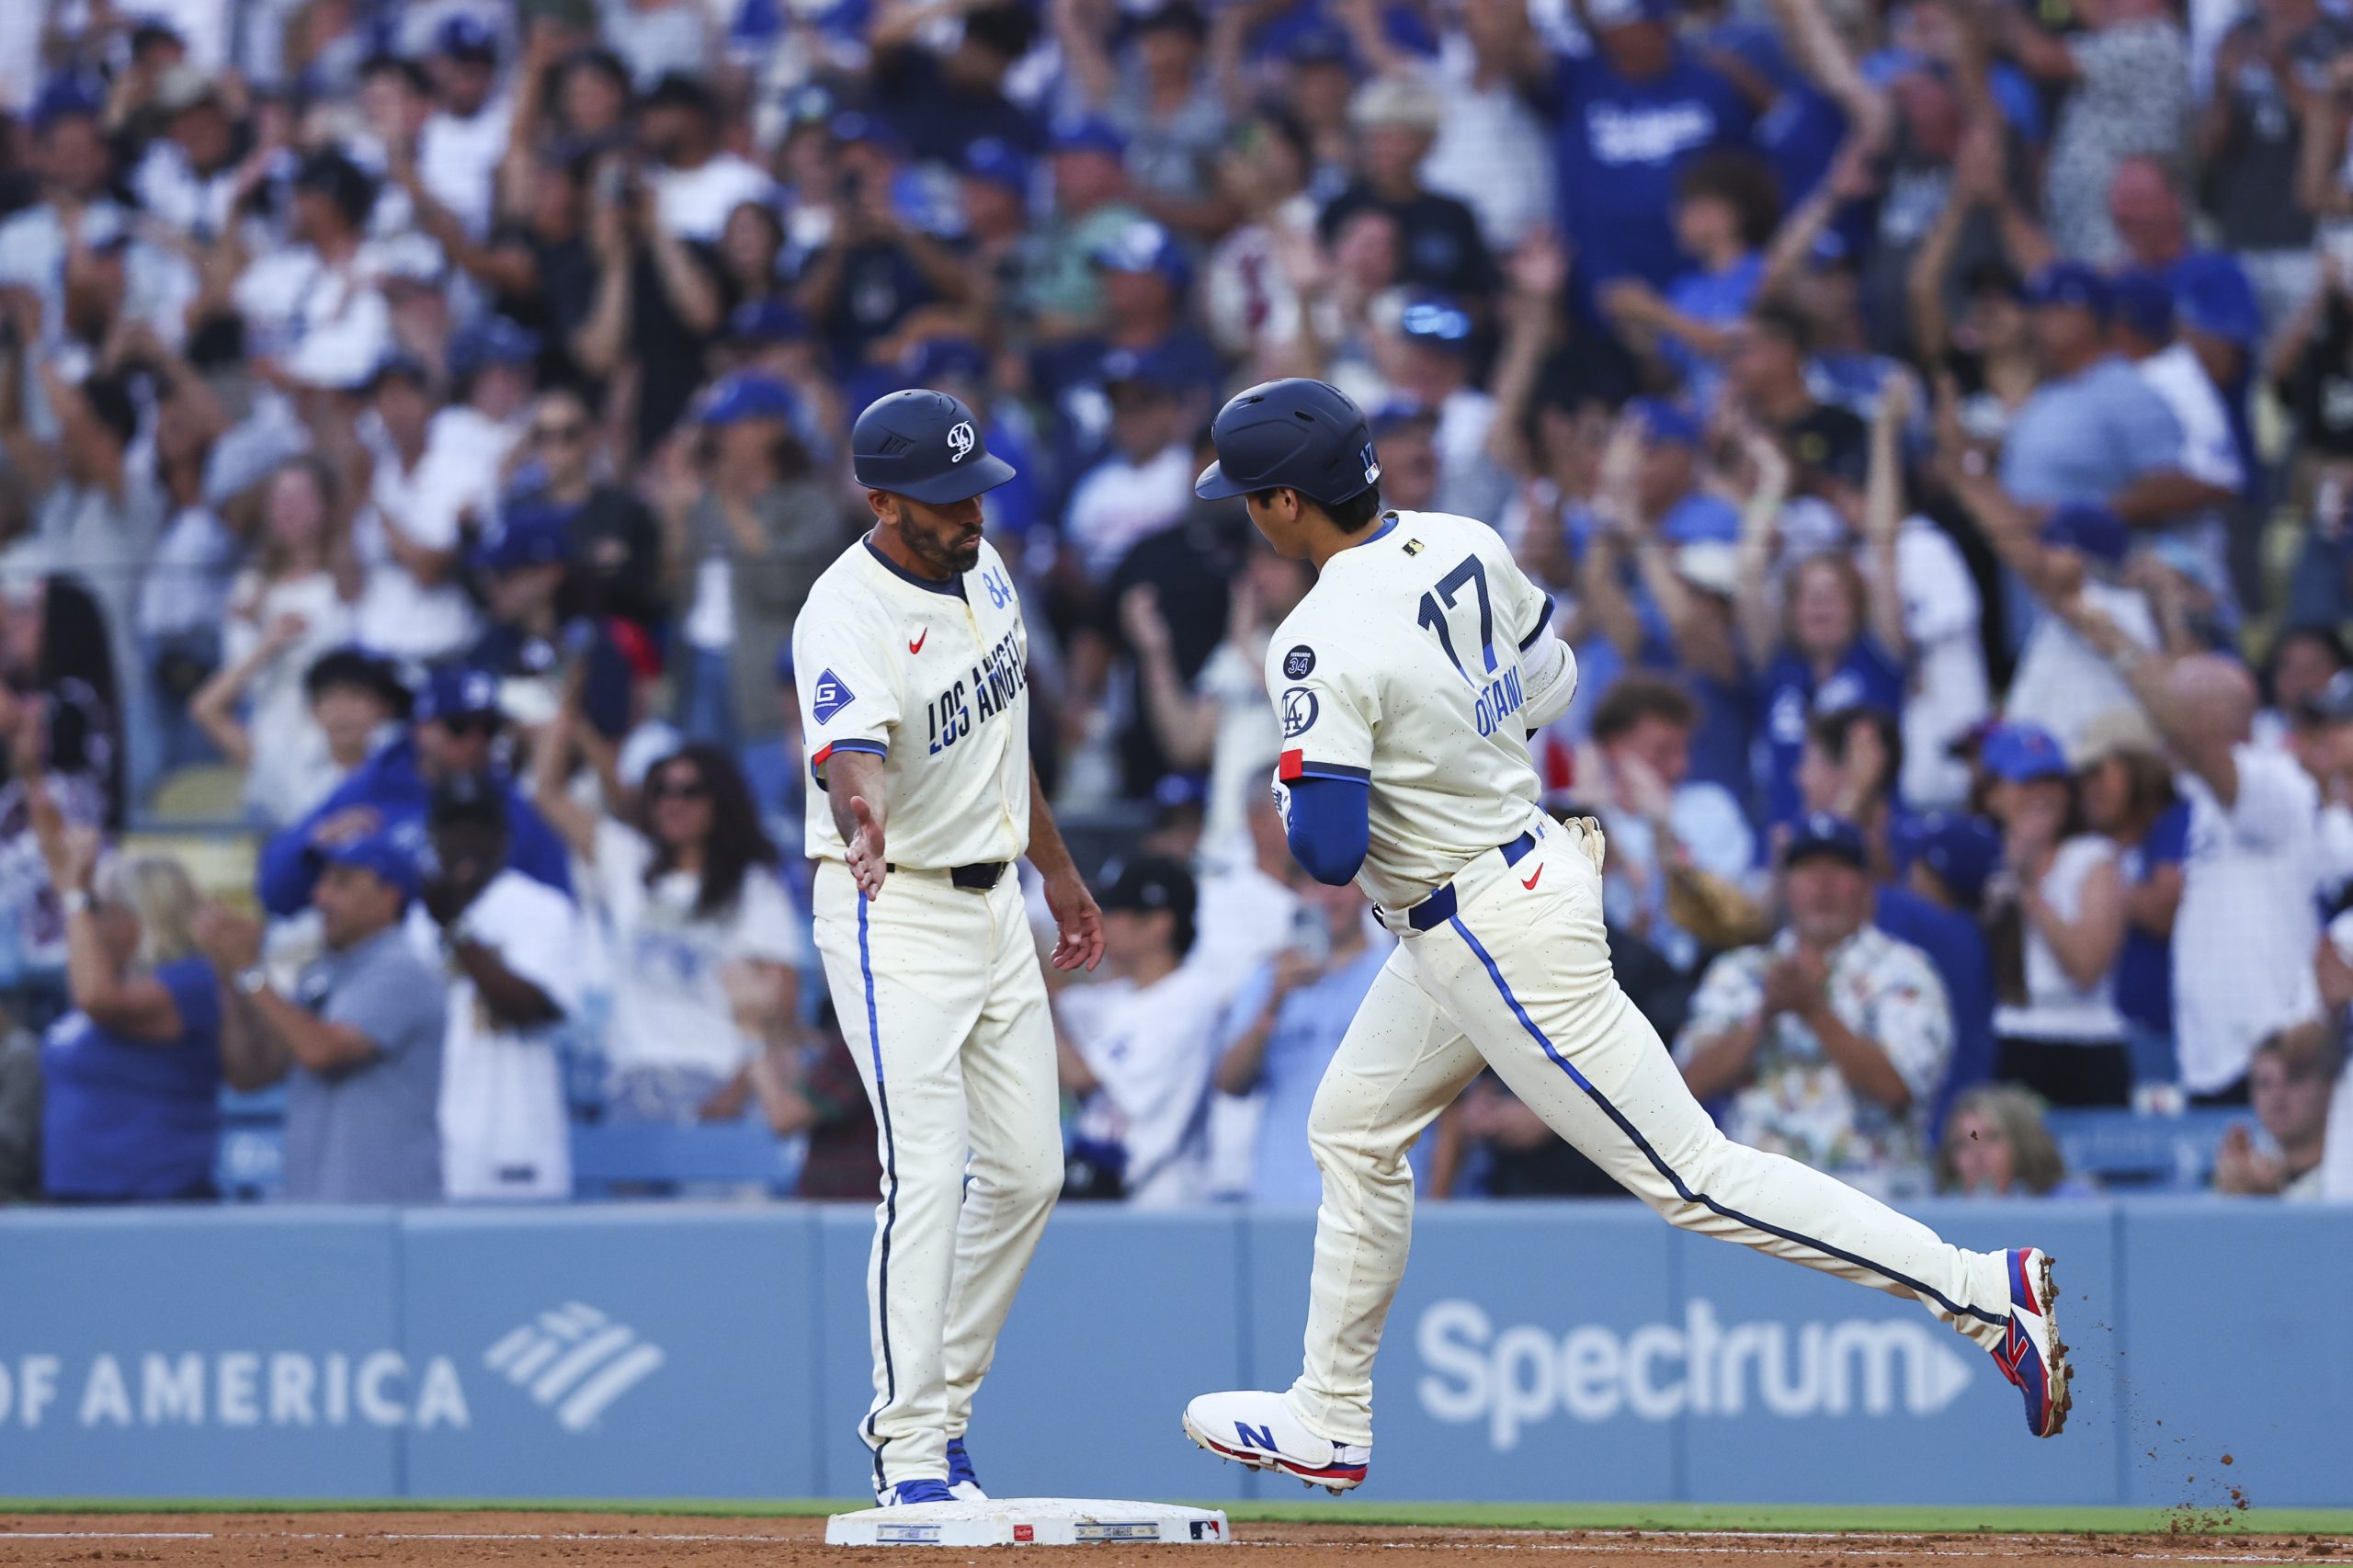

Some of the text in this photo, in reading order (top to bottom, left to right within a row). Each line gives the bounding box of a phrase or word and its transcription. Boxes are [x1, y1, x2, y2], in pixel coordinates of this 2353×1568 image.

[1360, 441, 1375, 469] 17
[982, 565, 1012, 609] 84
[1417, 553, 1498, 689] 17
[1288, 657, 1308, 674] 34
[927, 680, 971, 756] LOS
[0, 1349, 471, 1430] F AMERICA
[1417, 1299, 1938, 1450] Spectrum
[1234, 1421, 1279, 1453] N
